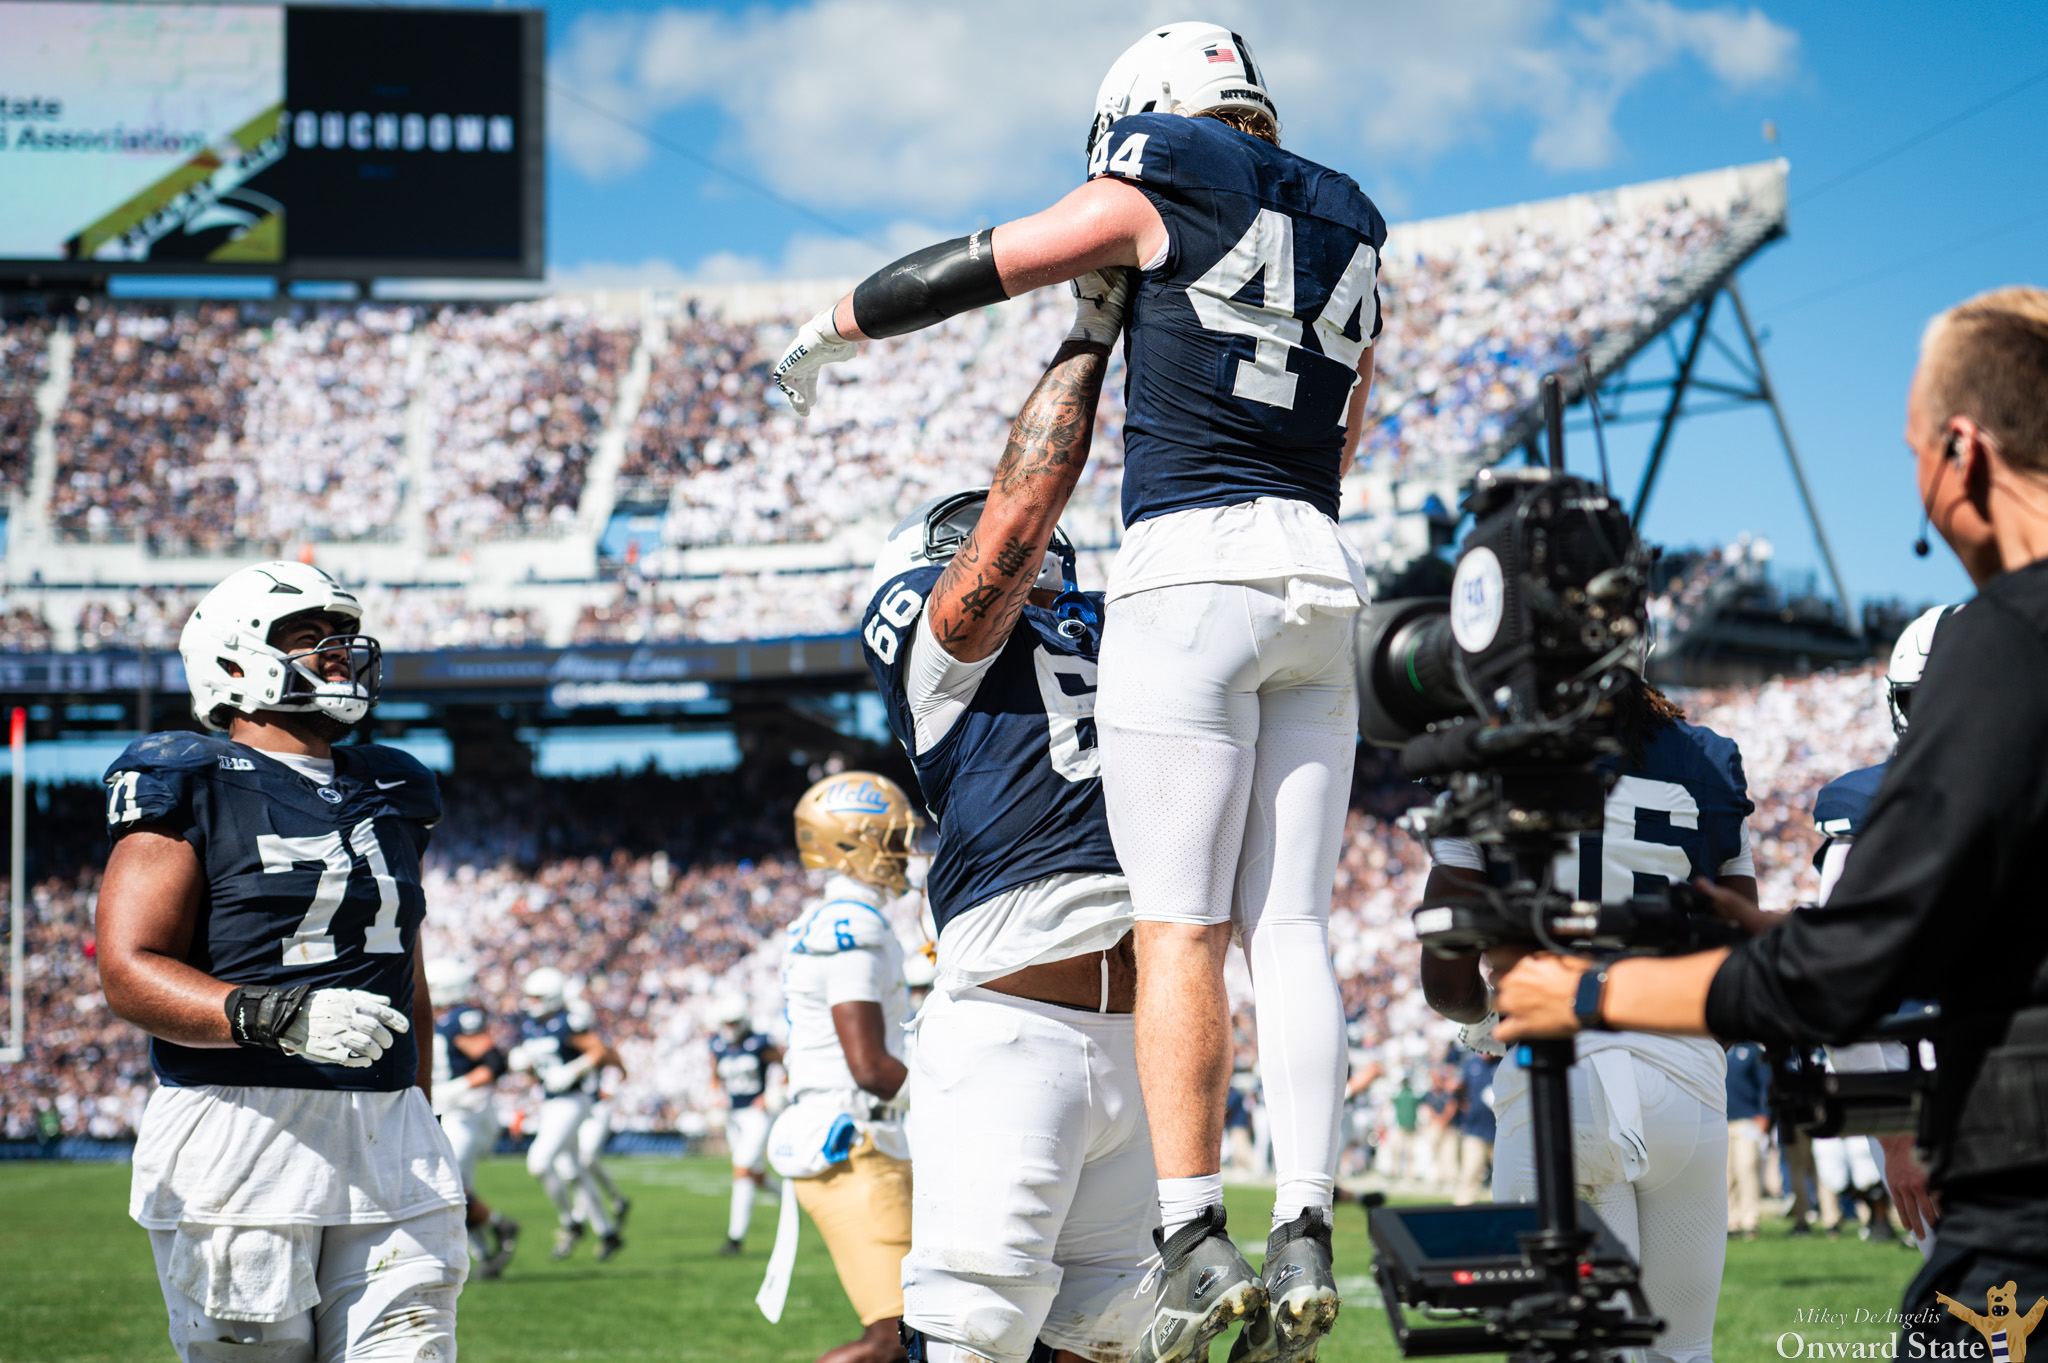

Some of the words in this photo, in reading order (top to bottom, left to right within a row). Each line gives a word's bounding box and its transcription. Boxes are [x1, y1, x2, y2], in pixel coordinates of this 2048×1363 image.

[0, 95, 62, 116] tate
[1220, 89, 1264, 102] NITTANY
[1089, 131, 1150, 181] 44
[1187, 208, 1379, 427] 44
[779, 344, 808, 373] STATE
[864, 581, 923, 666] 66
[1033, 643, 1102, 783] 6
[105, 770, 142, 825] 71
[257, 817, 405, 966] 71
[835, 919, 855, 950] 6
[1158, 1316, 1179, 1342] ALPHA
